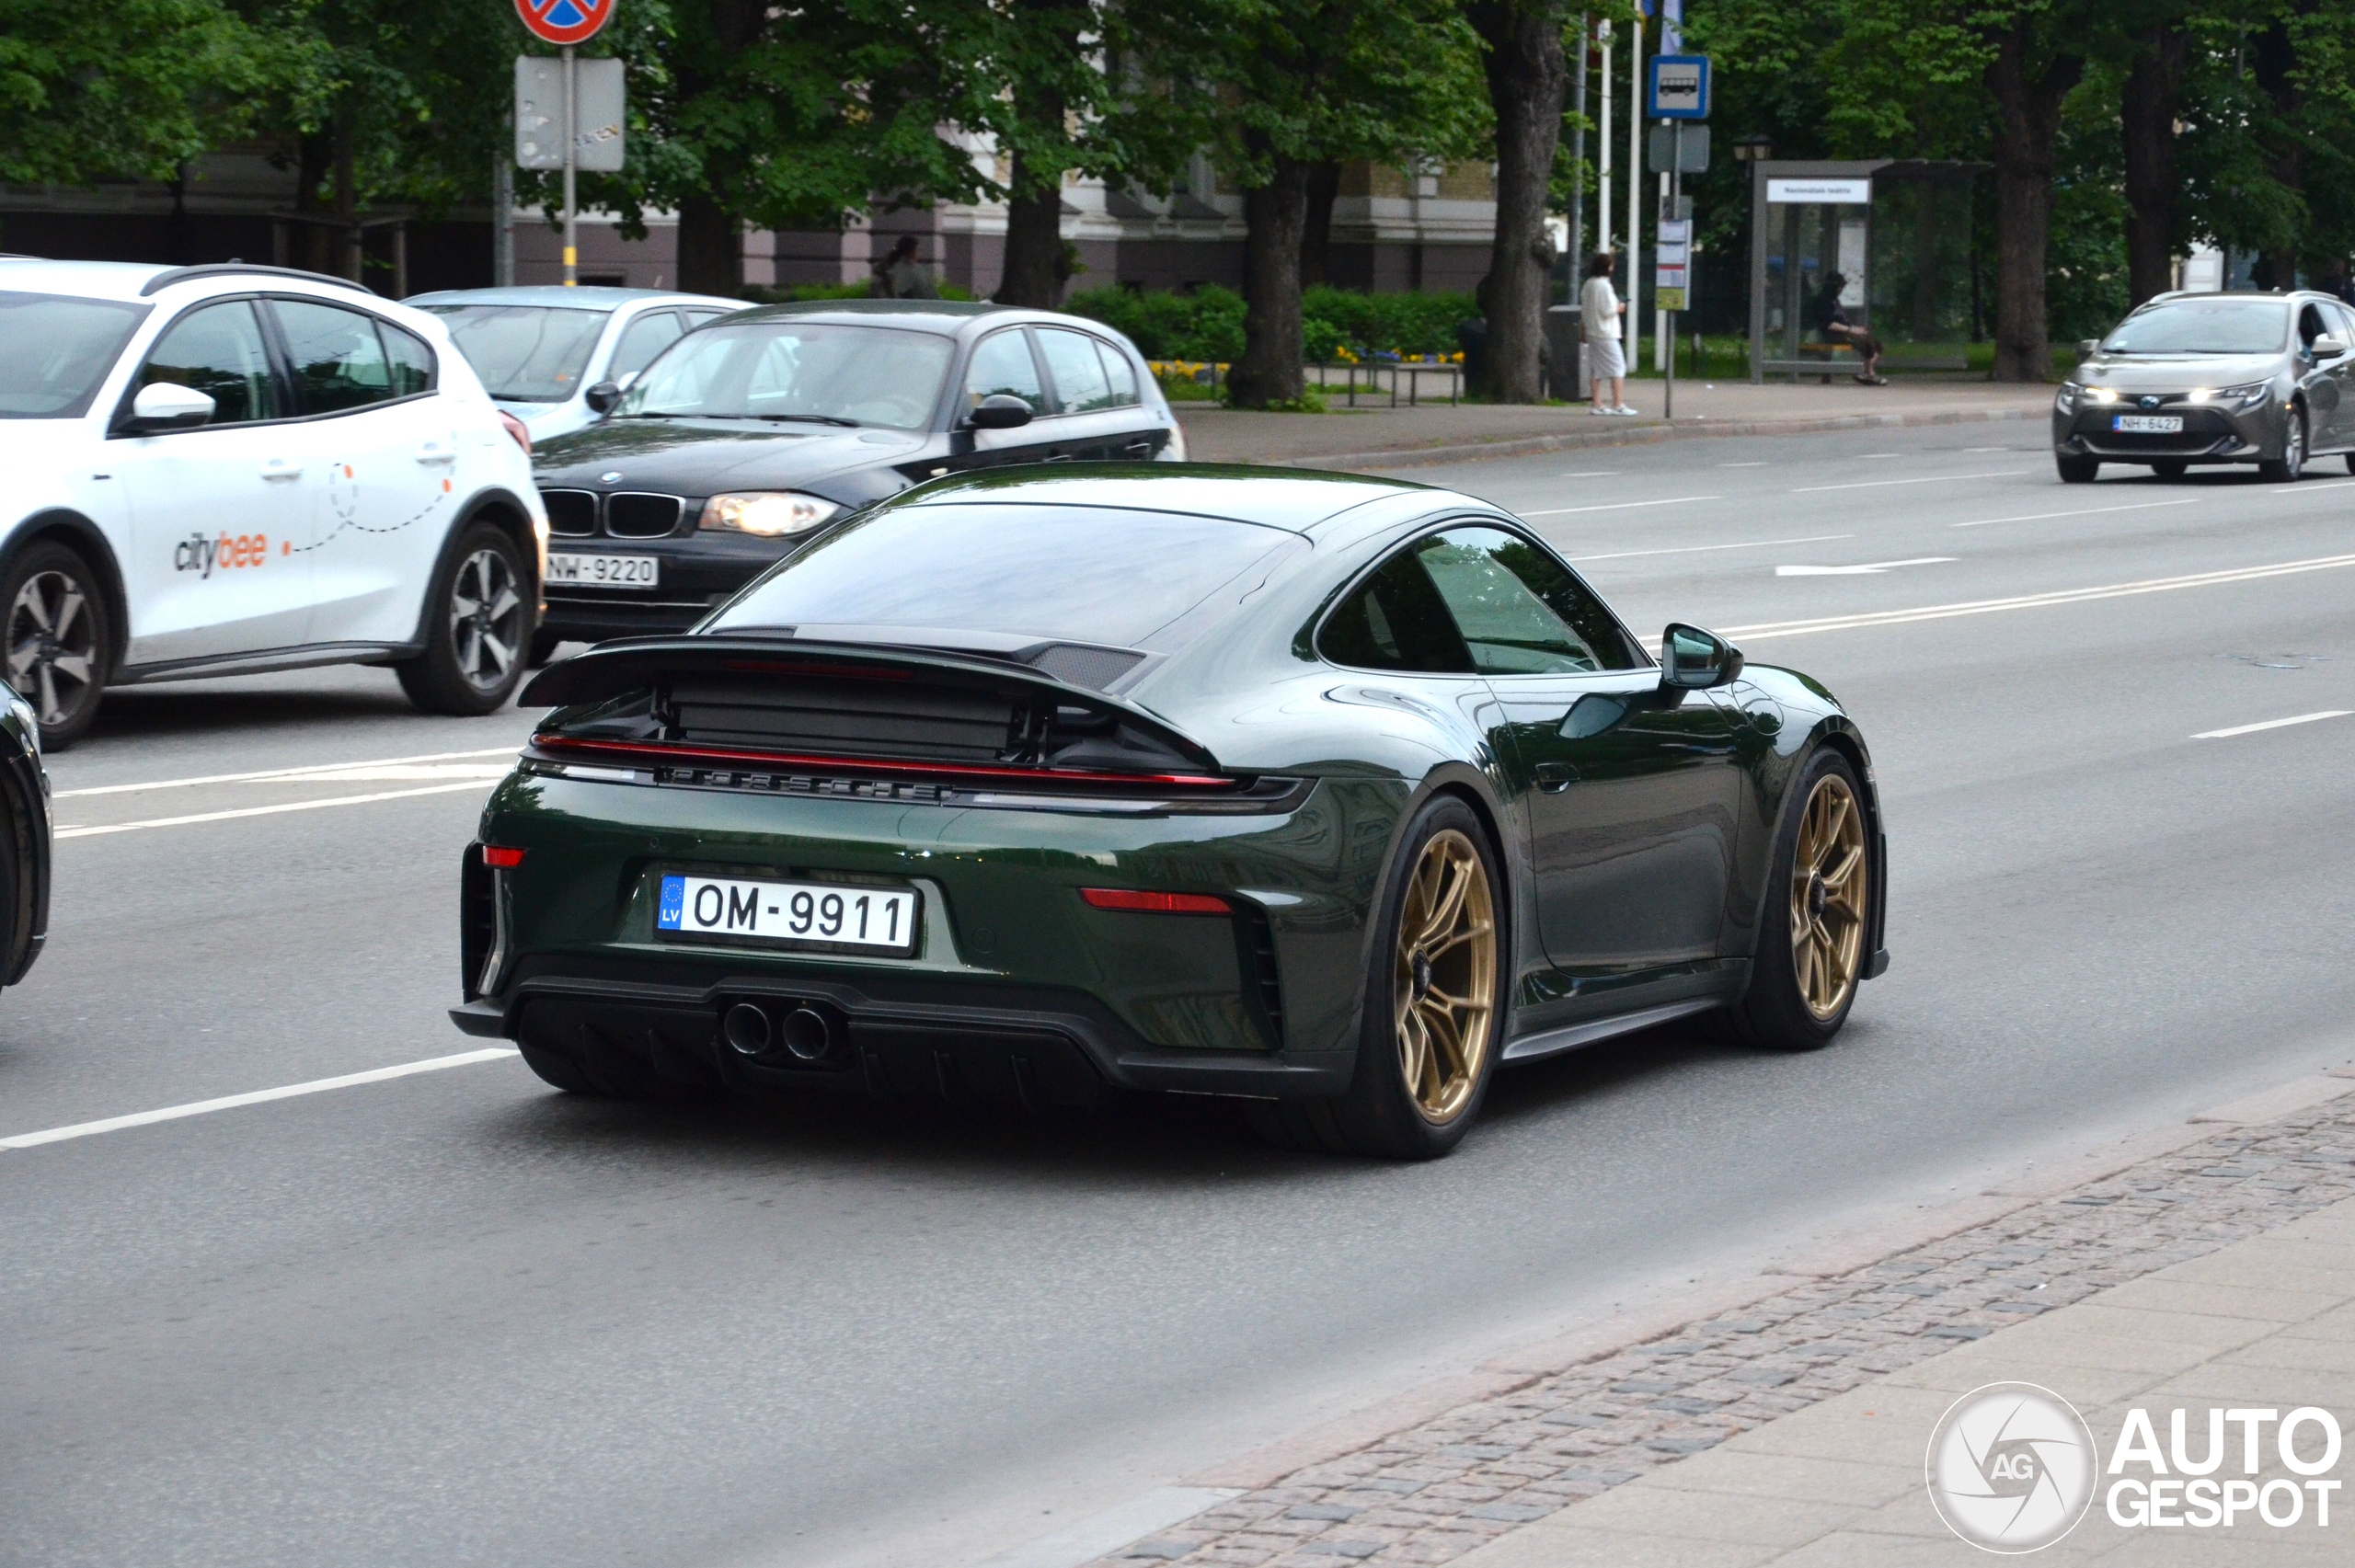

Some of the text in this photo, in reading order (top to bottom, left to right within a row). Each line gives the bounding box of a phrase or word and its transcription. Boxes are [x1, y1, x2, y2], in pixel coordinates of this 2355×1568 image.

[2121, 418, 2180, 430] NH-6427
[175, 531, 267, 579] citybee
[547, 556, 652, 581] NW-9220
[672, 769, 936, 797] PORSCHE
[662, 909, 680, 921] LV
[695, 884, 900, 942] OM-9911
